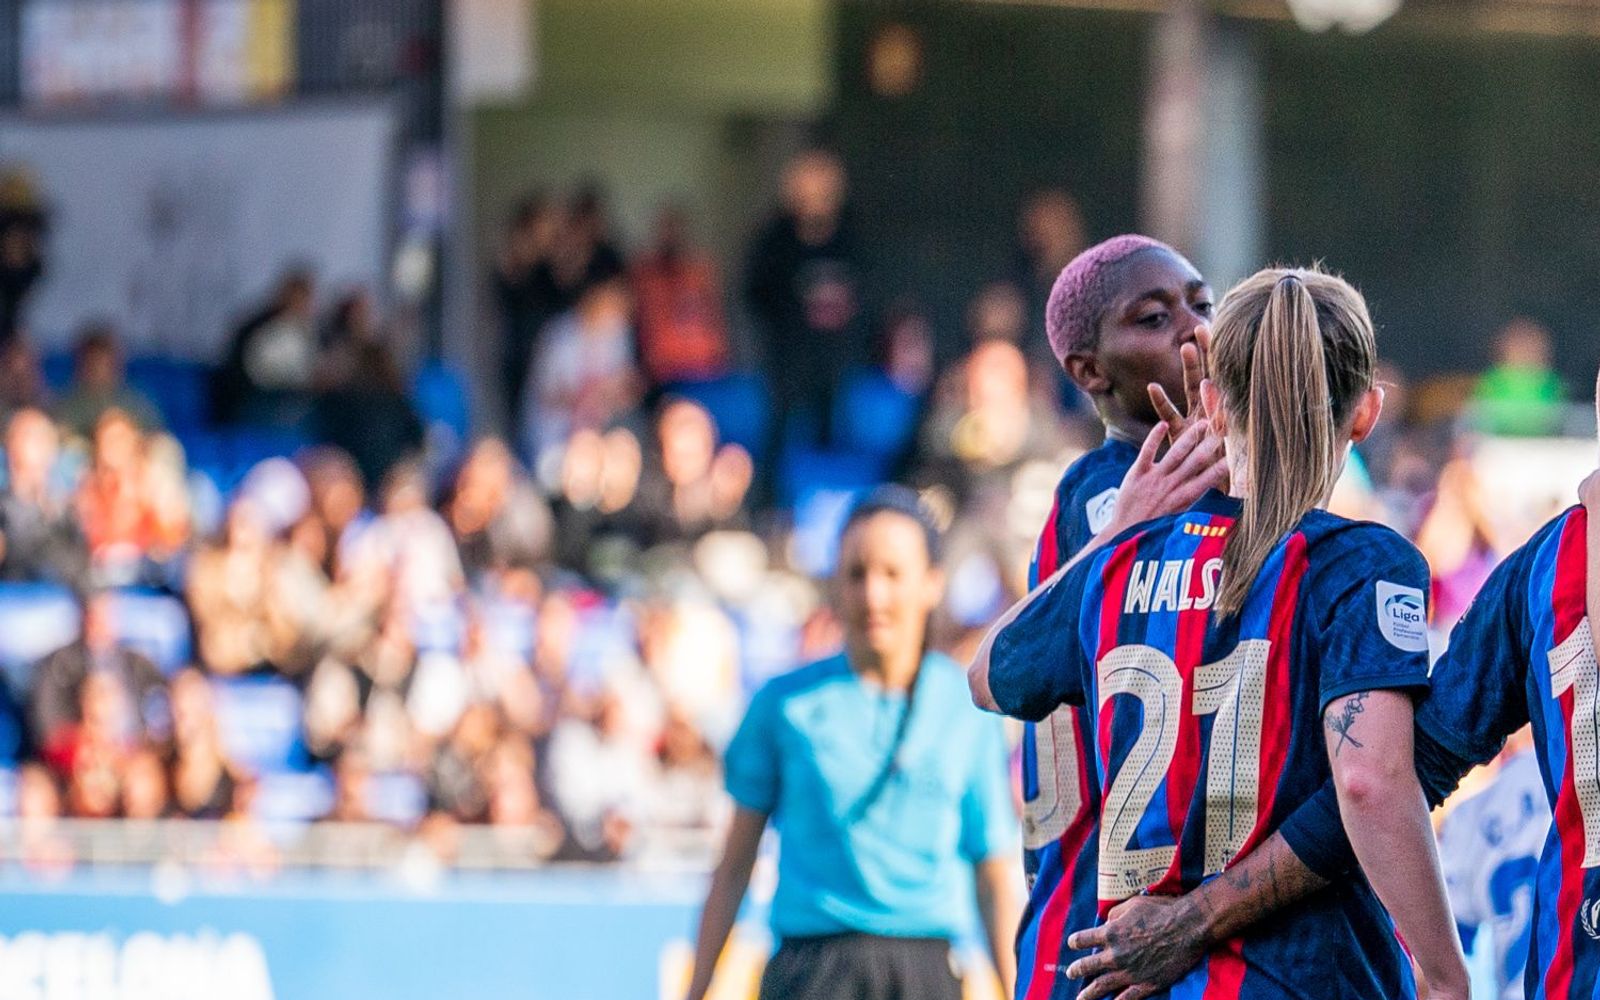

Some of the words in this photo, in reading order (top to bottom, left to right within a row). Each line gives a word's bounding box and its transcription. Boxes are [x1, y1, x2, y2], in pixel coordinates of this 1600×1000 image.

[1123, 557, 1223, 614] WALS
[1392, 607, 1420, 623] Liga
[1097, 639, 1272, 901] 21
